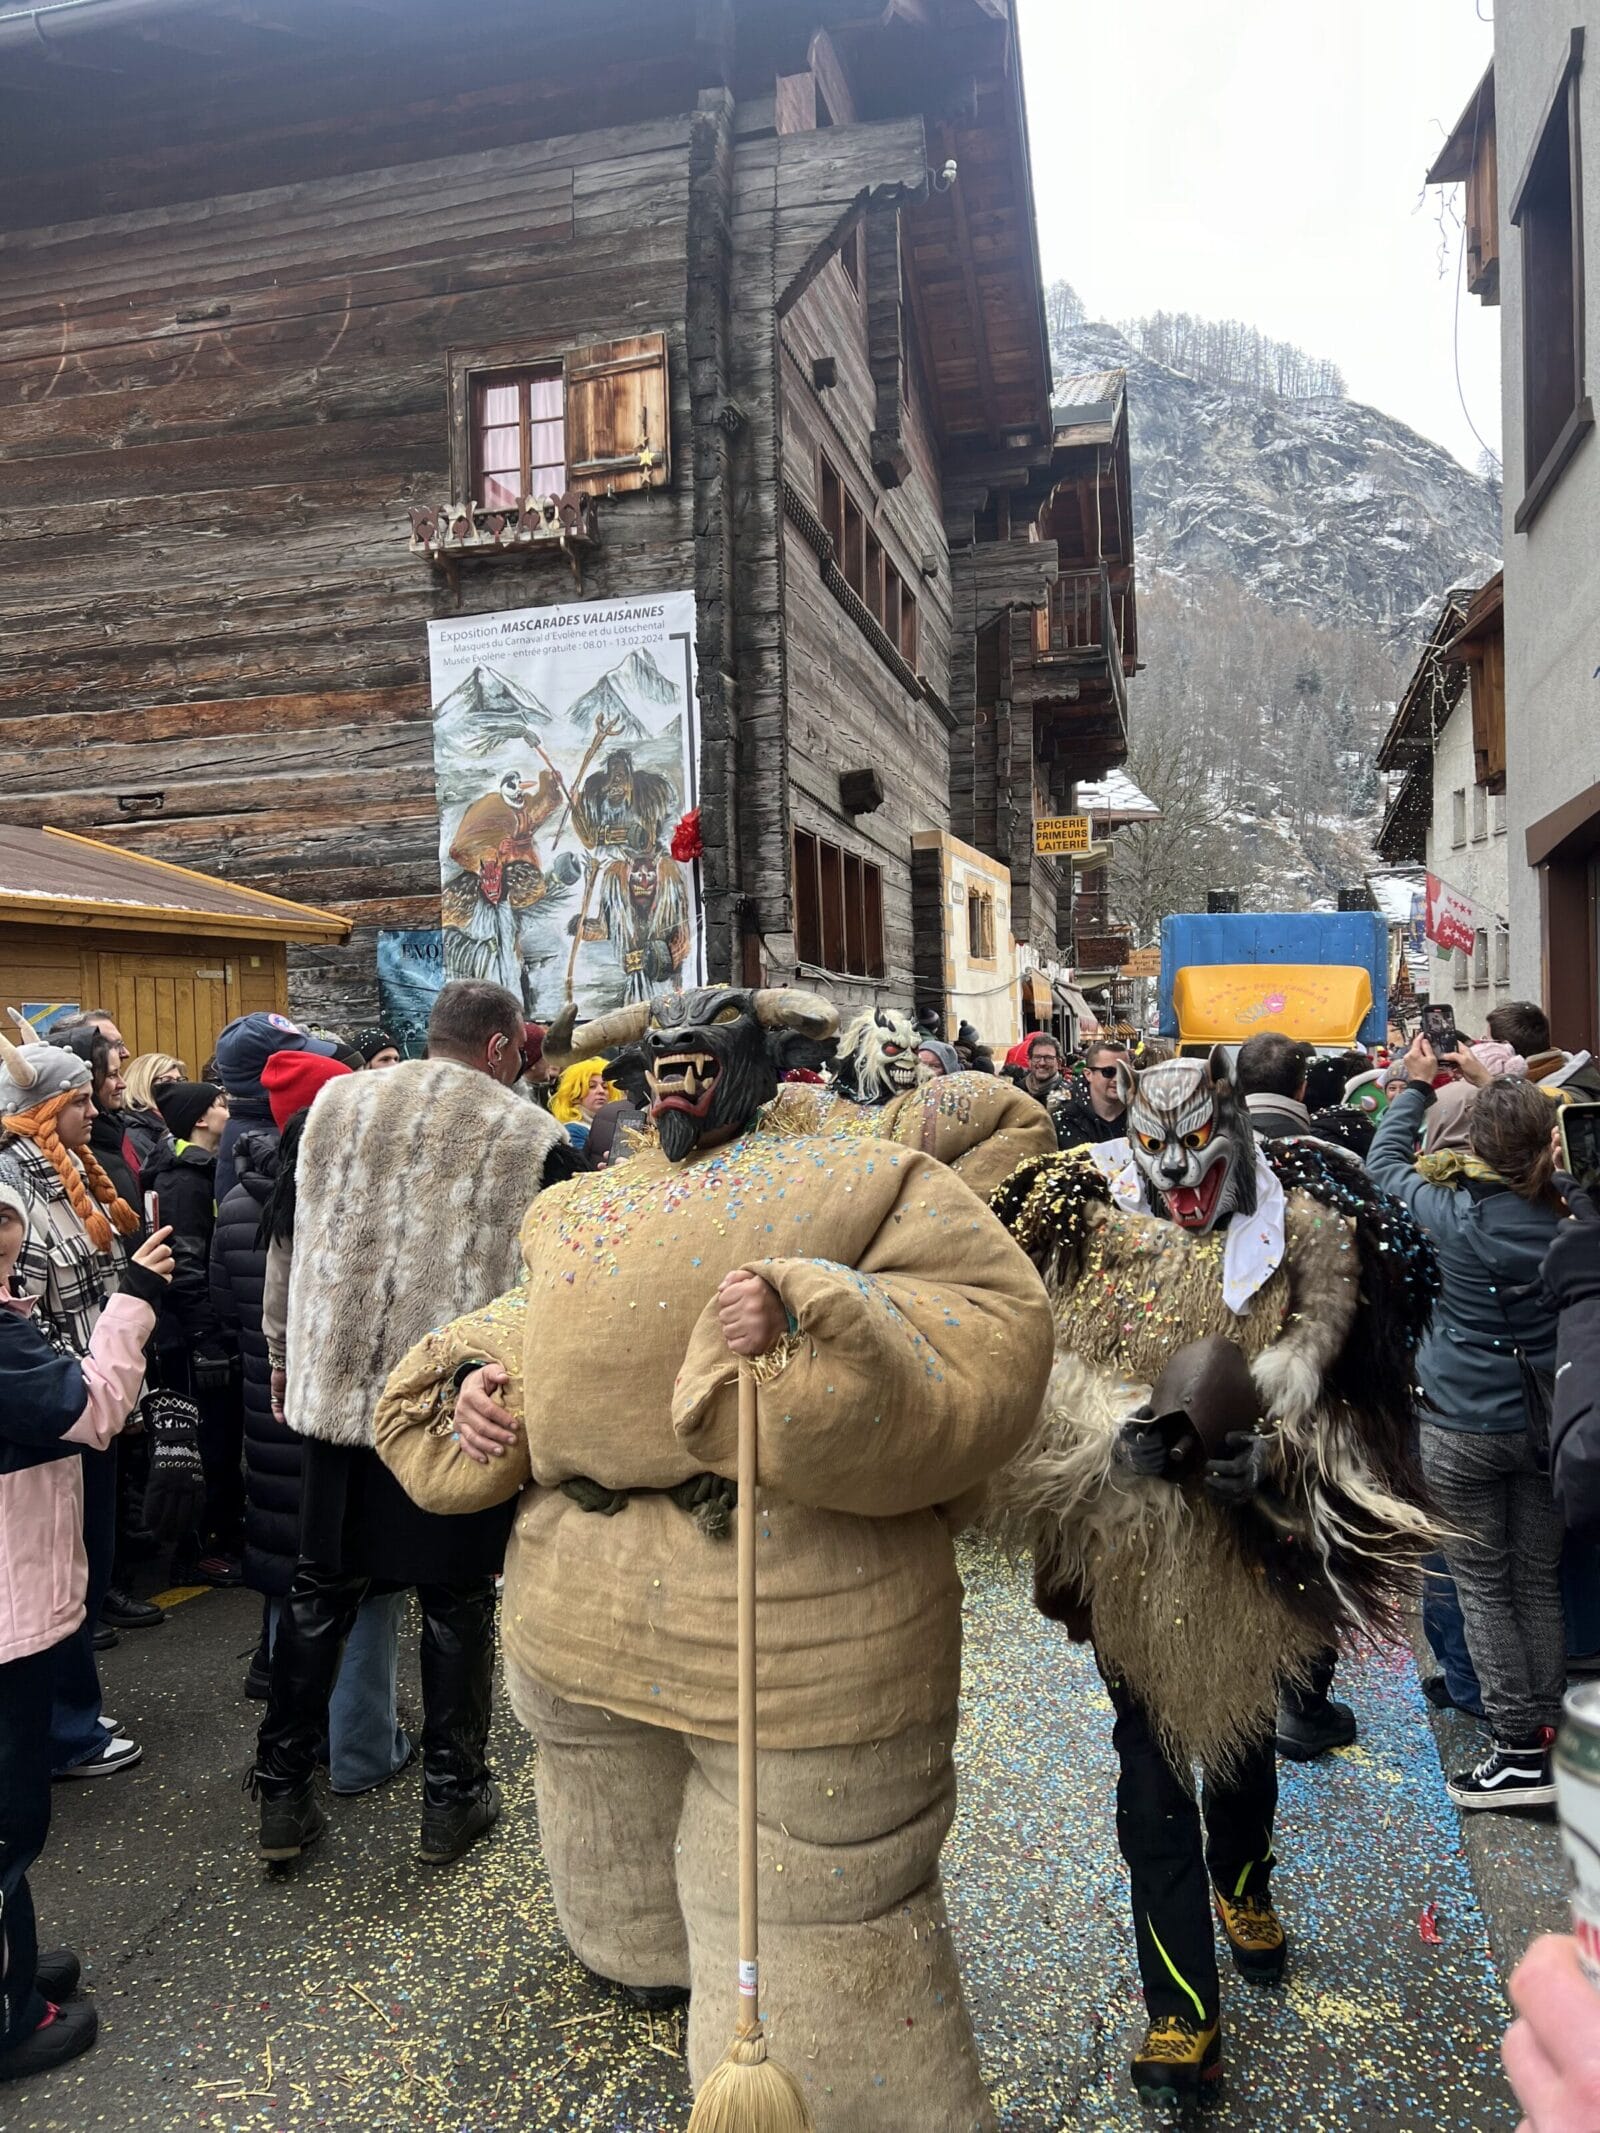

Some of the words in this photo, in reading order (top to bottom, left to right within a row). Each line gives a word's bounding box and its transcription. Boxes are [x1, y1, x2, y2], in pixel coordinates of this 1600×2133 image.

[440, 626, 498, 643] Exposition
[500, 615, 580, 634] MASCARADES
[583, 605, 665, 624] VALAISANNES
[453, 641, 490, 652] Masques
[492, 639, 503, 648] du
[505, 634, 543, 646] Carnaval
[588, 629, 598, 637] et
[599, 626, 612, 636] du
[443, 655, 471, 666] Musée
[513, 648, 540, 658] entrée
[542, 643, 576, 655] gratuite
[583, 640, 607, 650] 08.01
[616, 634, 664, 647] 13.02.2024
[1036, 819, 1087, 830] EPICERIE
[1036, 829, 1088, 840] PRIMEURS
[1037, 840, 1087, 851] LAITERIE
